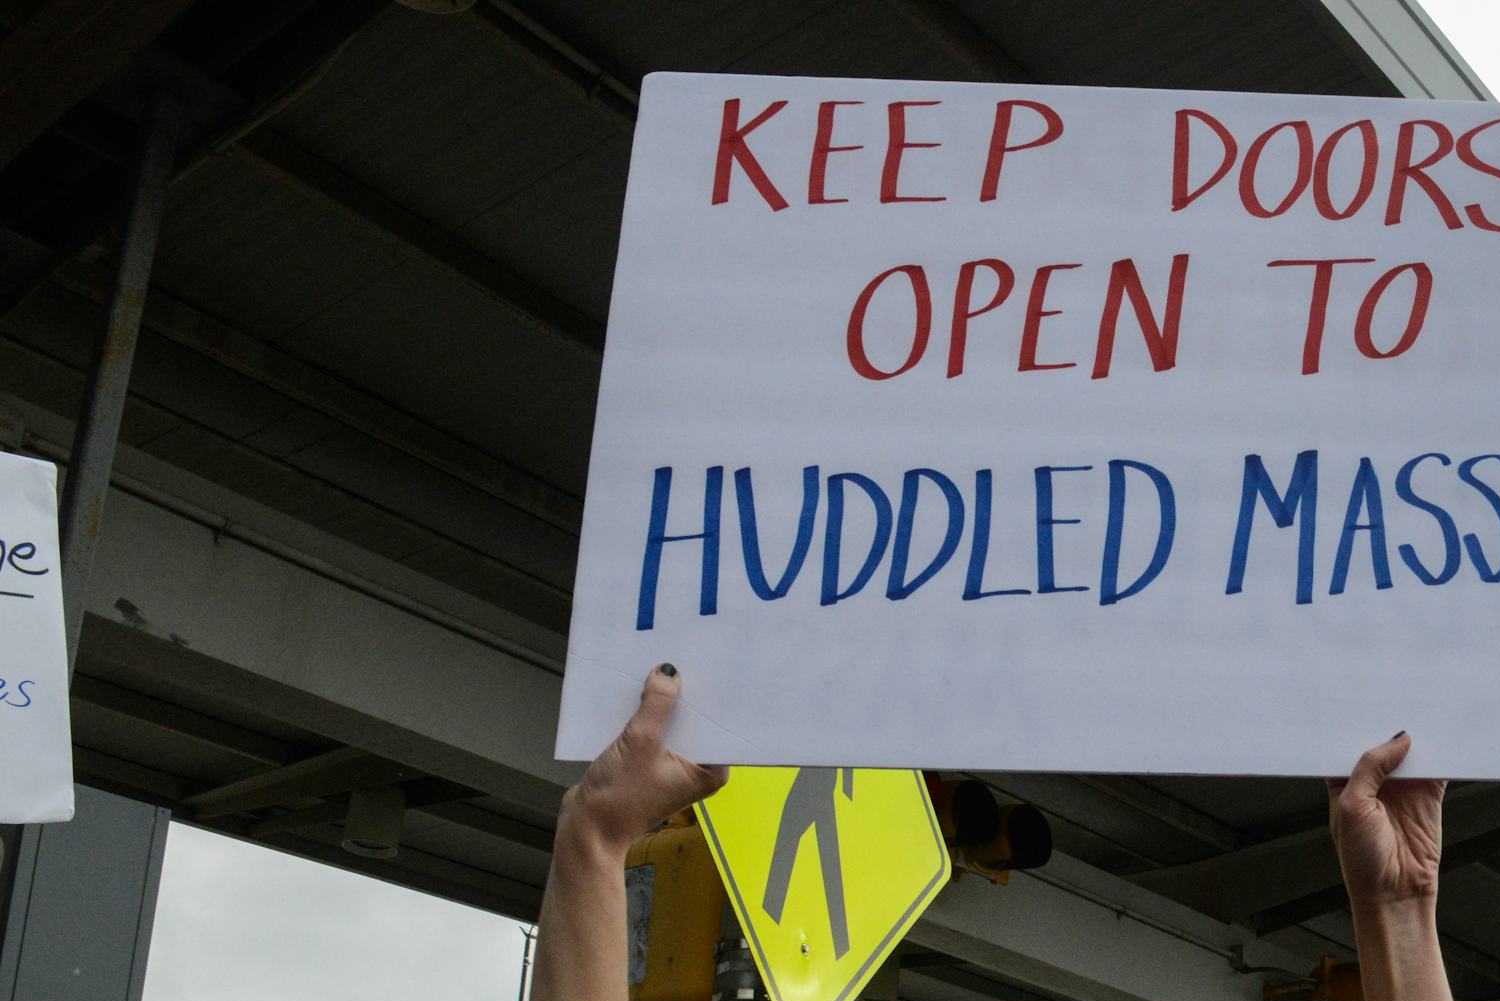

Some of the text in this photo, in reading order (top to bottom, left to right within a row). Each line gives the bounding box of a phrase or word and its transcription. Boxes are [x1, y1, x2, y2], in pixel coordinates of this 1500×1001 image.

[713, 97, 1064, 211] KEEP
[847, 254, 1433, 380] OPEN TO
[635, 453, 1177, 631] HUDDLED
